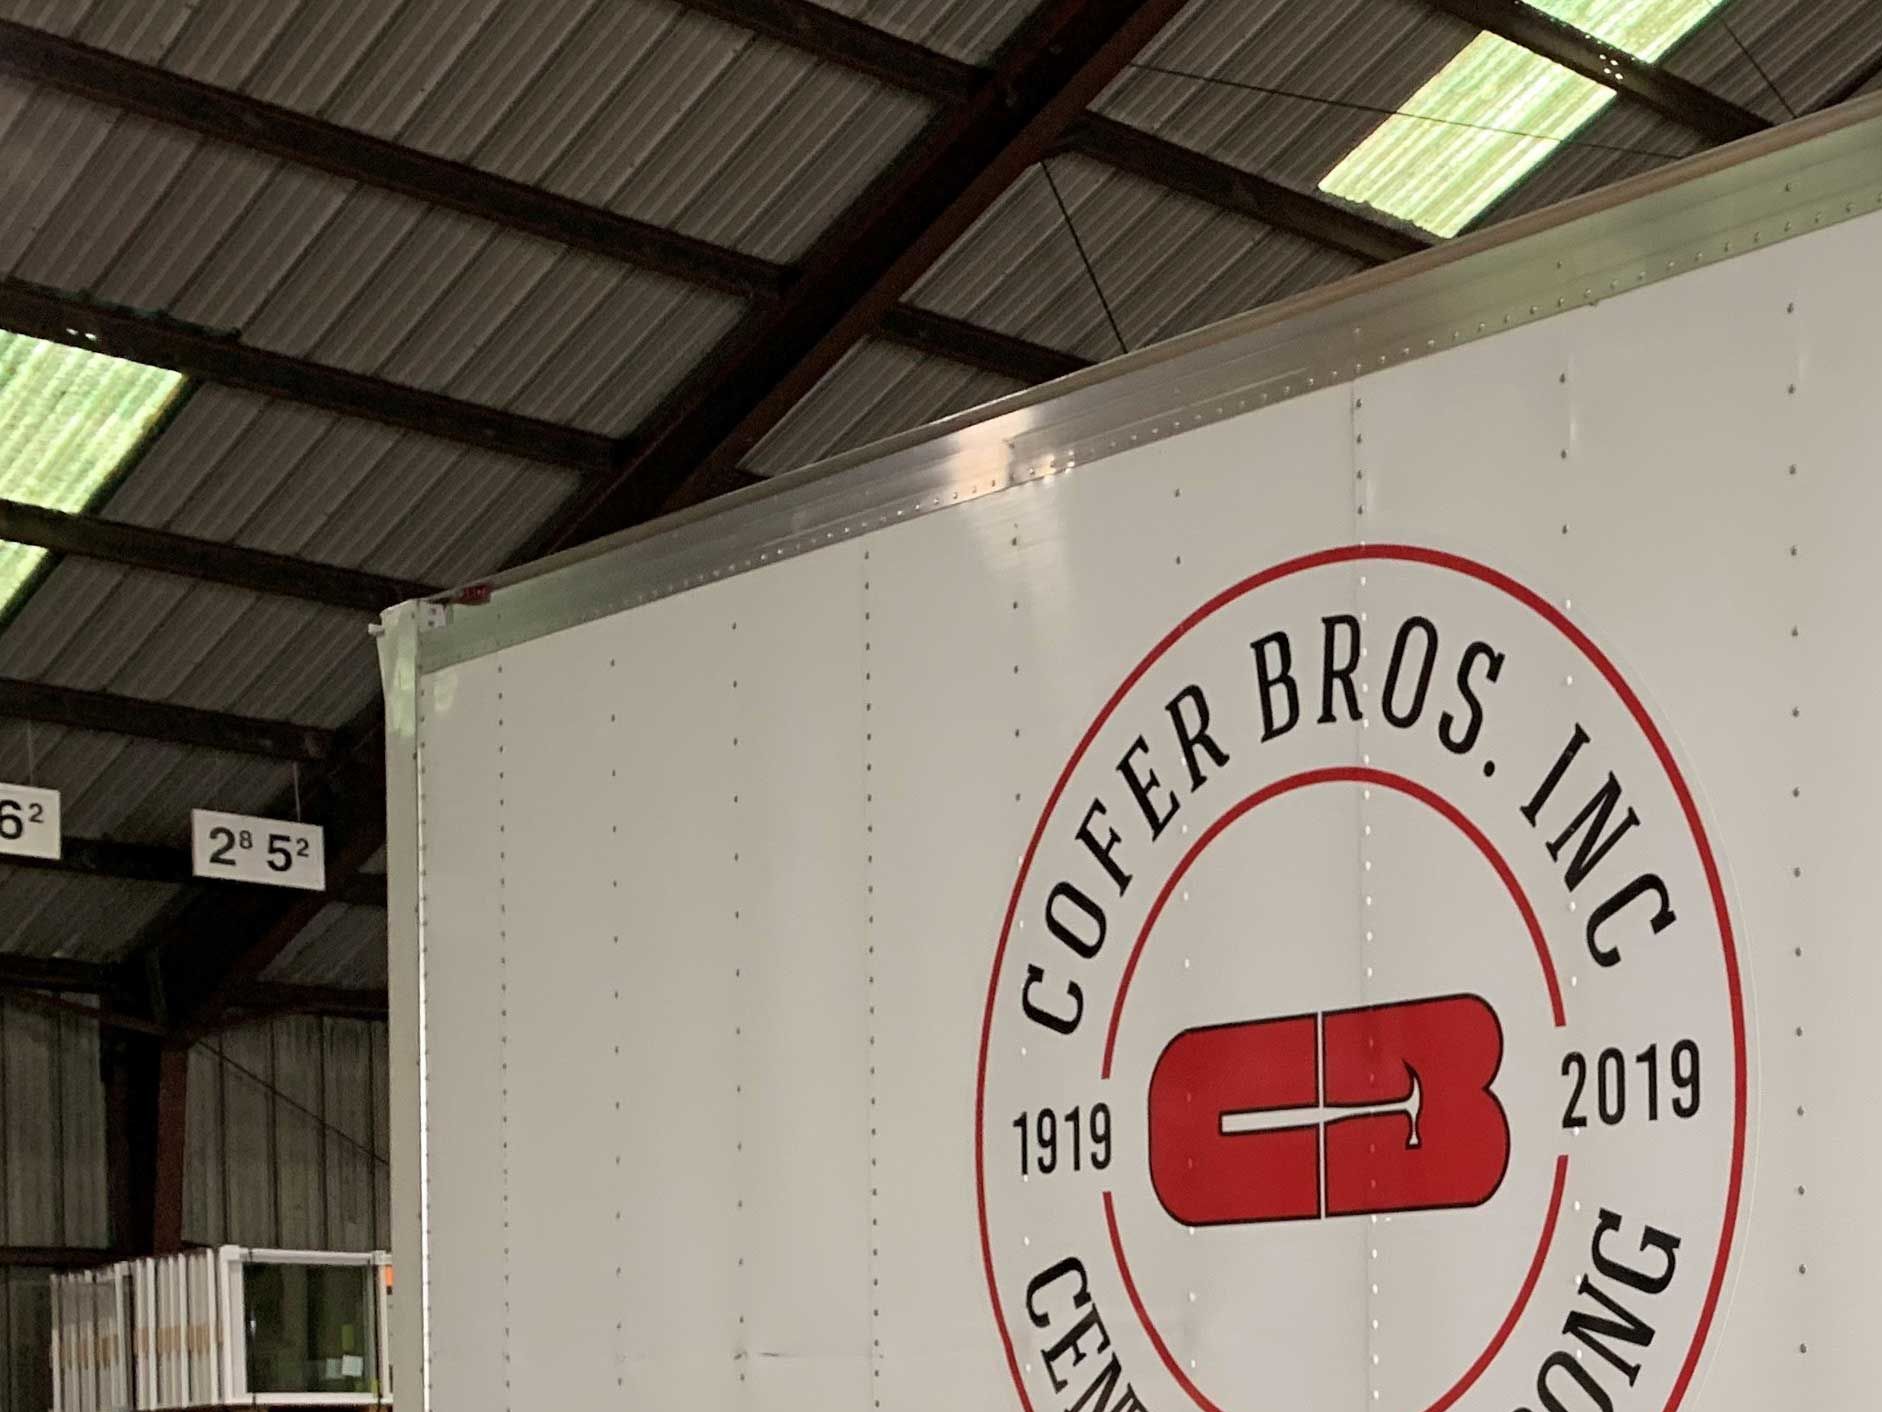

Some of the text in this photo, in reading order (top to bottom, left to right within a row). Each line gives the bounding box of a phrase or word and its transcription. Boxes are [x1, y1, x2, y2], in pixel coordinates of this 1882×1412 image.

[1020, 613, 1677, 1036] COFER BROS. INC
[1560, 1038, 1702, 1130] 2019
[1012, 1101, 1113, 1176] 1919
